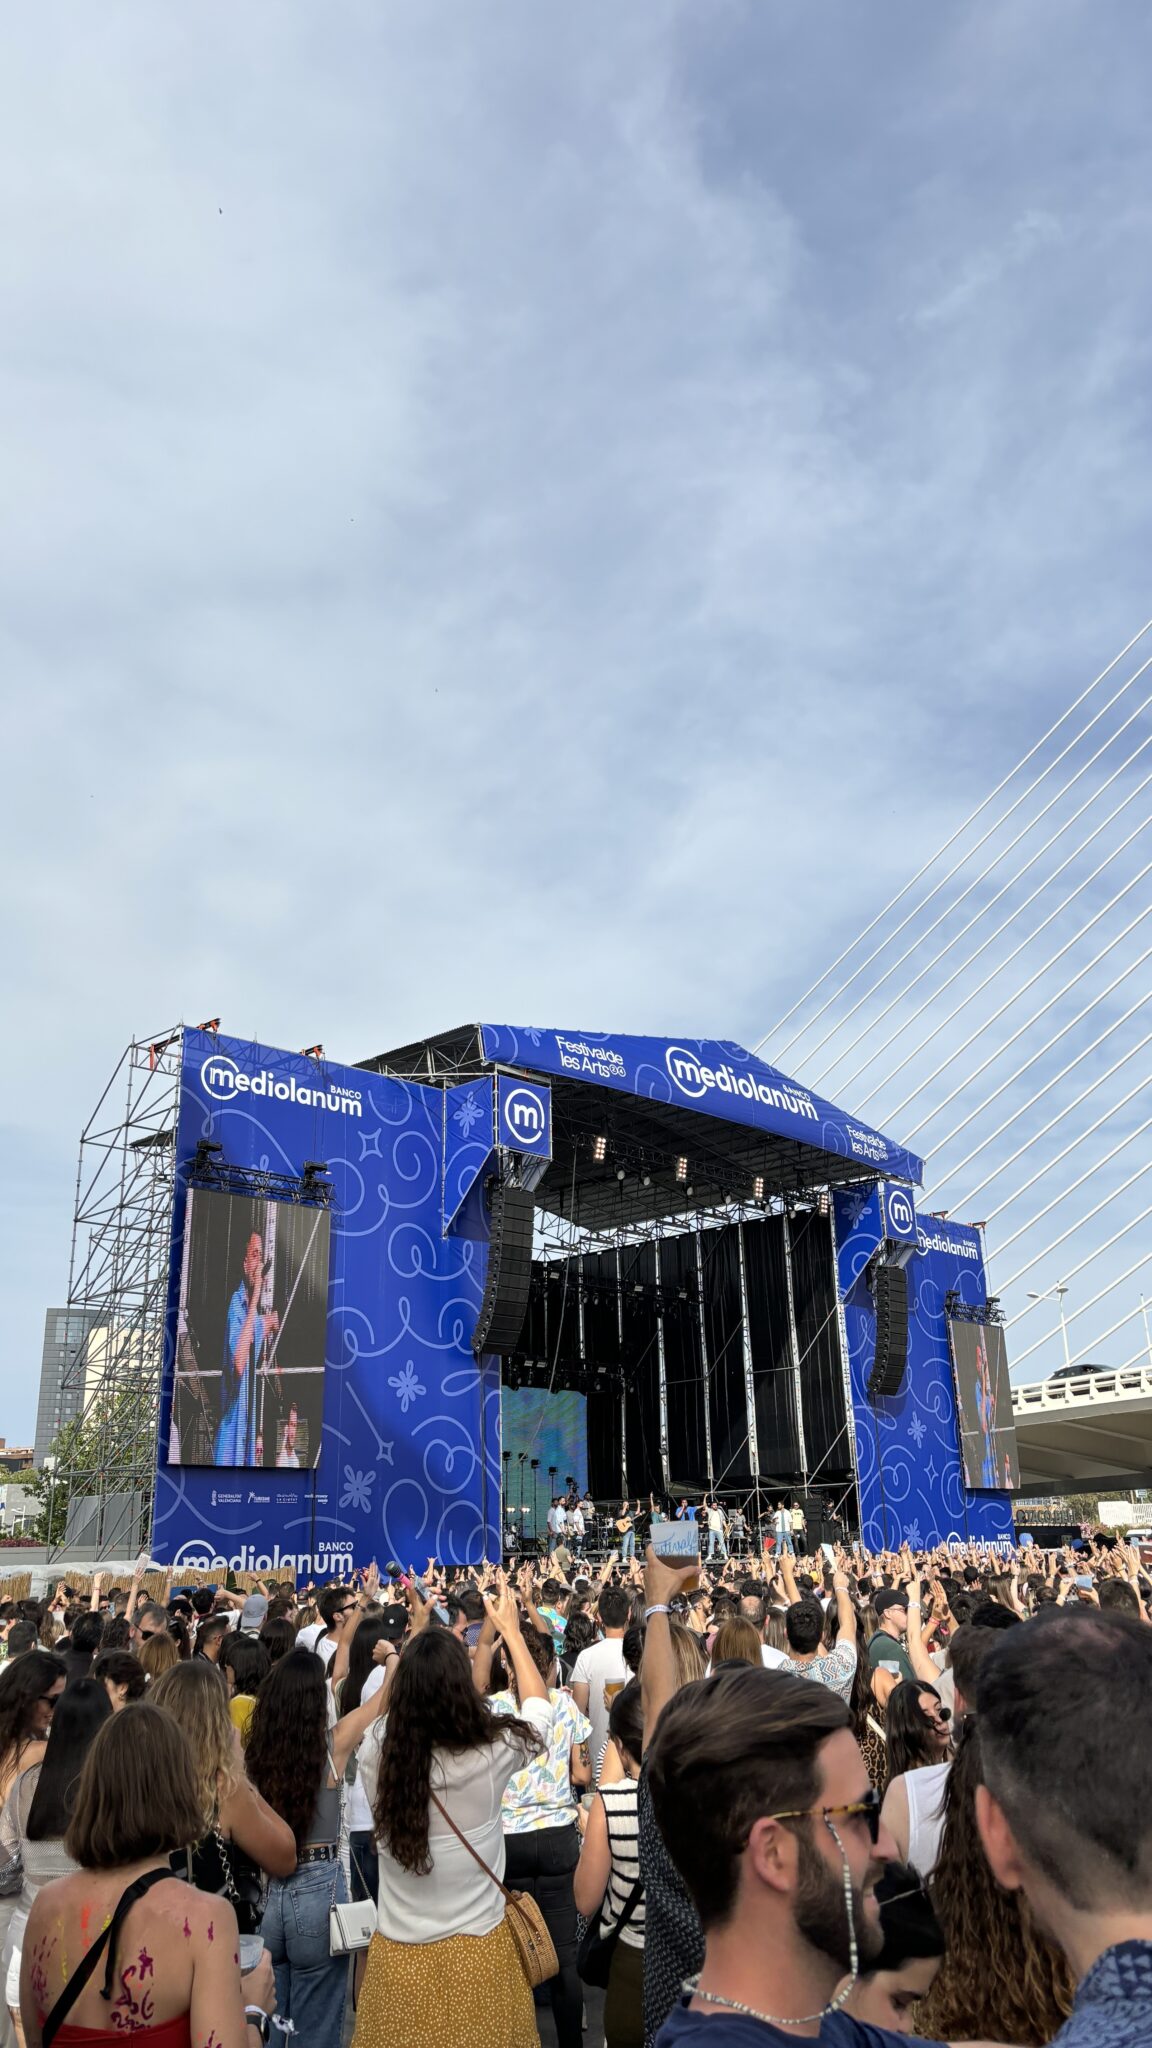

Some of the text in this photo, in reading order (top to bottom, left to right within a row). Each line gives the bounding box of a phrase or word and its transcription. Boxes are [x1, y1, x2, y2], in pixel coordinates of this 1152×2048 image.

[560, 1050, 580, 1070] les
[582, 1056, 610, 1078] Arts
[201, 1056, 363, 1118] mediolanum
[331, 1084, 362, 1100] BANCO
[666, 1047, 820, 1121] mediolanum
[782, 1084, 811, 1101] BANCO
[513, 1103, 538, 1129] m
[894, 1202, 910, 1223] m
[318, 1542, 354, 1552] BANCO
